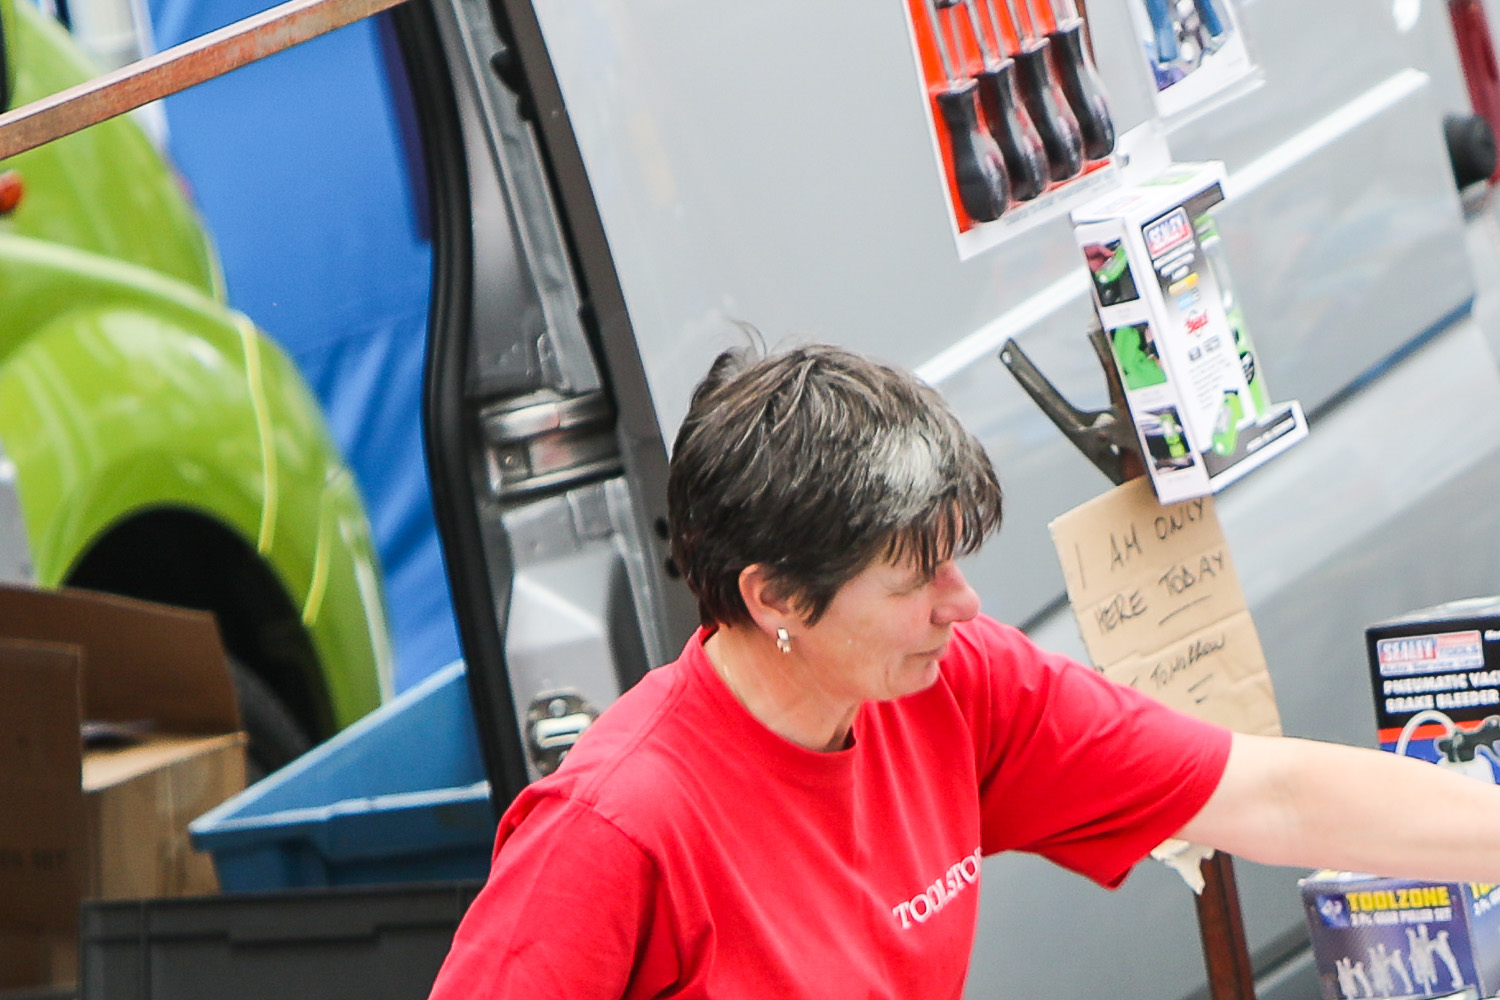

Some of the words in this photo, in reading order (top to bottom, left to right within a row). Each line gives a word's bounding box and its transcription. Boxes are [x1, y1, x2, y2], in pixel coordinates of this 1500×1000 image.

[1158, 550, 1224, 597] TODAY
[1383, 673, 1468, 696] PNEUMATIC
[1345, 885, 1451, 912] TOOLZONE
